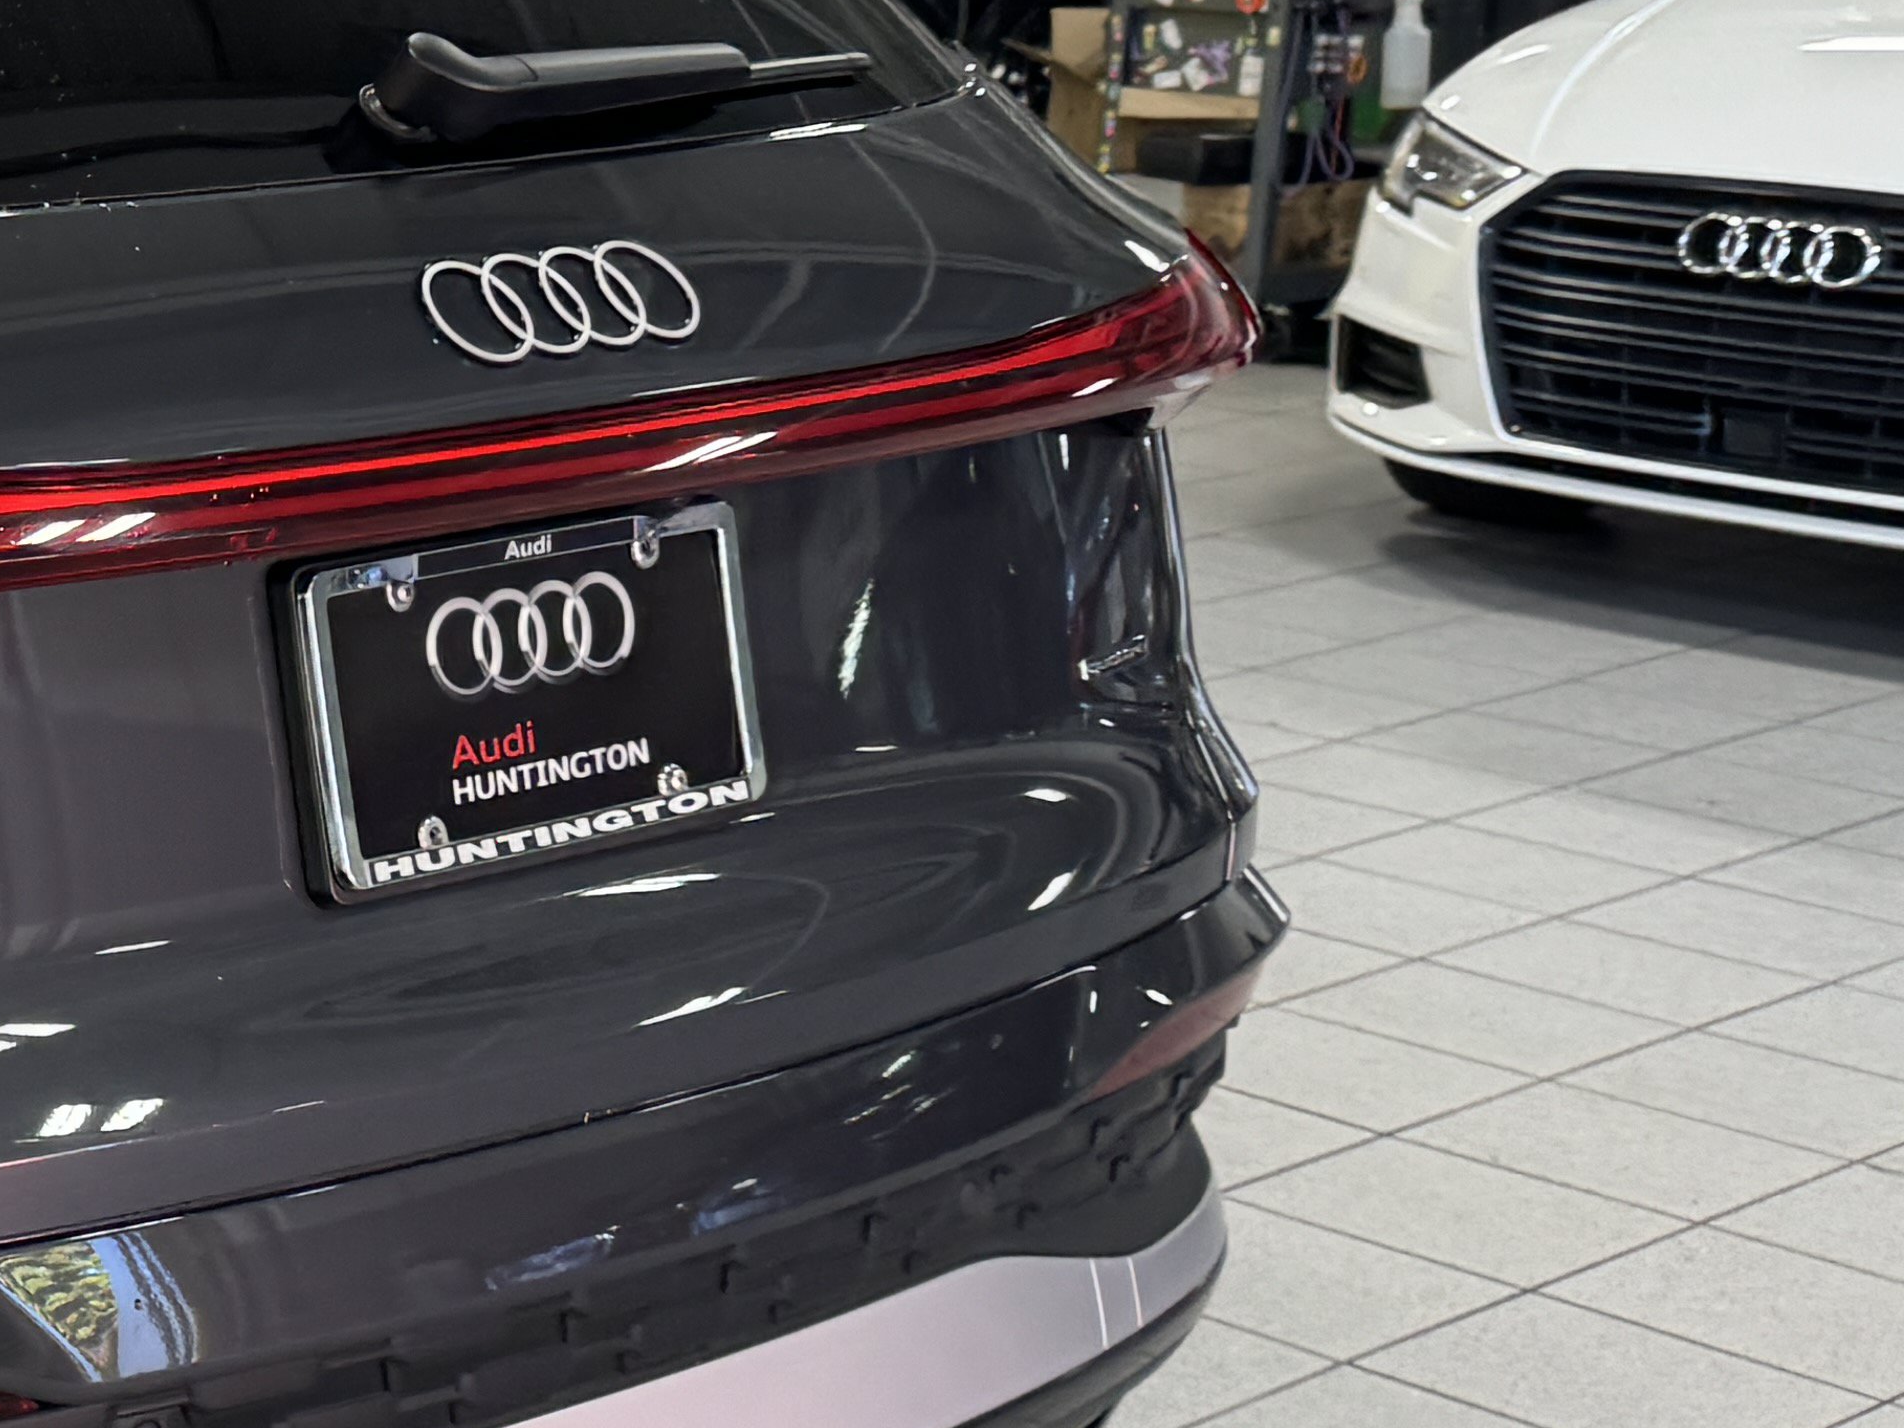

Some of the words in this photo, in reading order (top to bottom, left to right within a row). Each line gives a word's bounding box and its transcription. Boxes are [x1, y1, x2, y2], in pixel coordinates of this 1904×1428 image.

[504, 534, 553, 561] Audi
[451, 720, 537, 770] Audi
[451, 736, 652, 806] HUNTINGTON
[374, 779, 752, 883] HUNTINGTON
